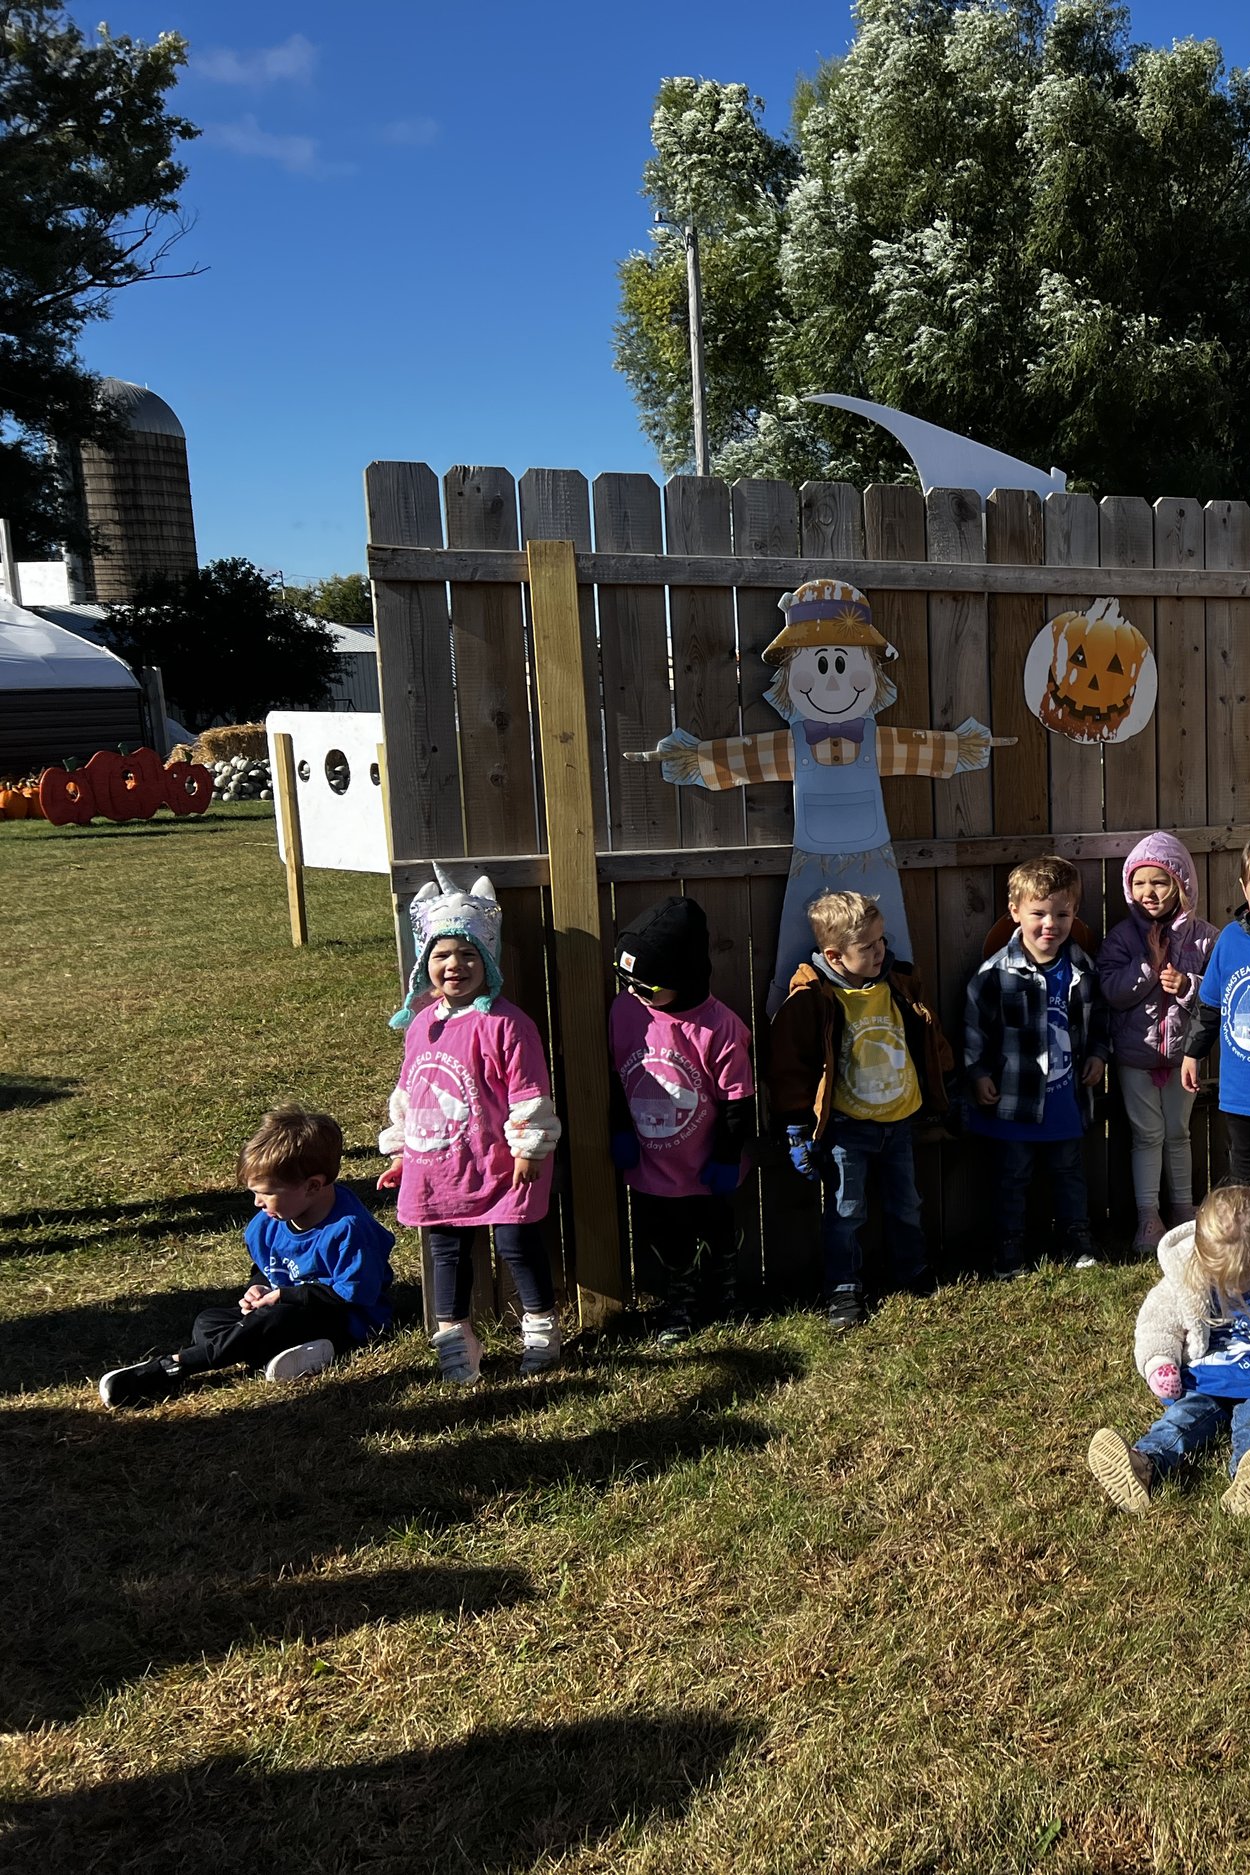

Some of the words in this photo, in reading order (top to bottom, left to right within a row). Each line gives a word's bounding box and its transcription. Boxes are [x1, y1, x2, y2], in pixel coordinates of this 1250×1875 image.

[435, 1051, 480, 1104] PRESCHOOL
[660, 1047, 702, 1090] PRESCHOOL
[646, 1140, 663, 1152] day
[680, 1124, 698, 1141] field
[696, 1109, 708, 1124] trip
